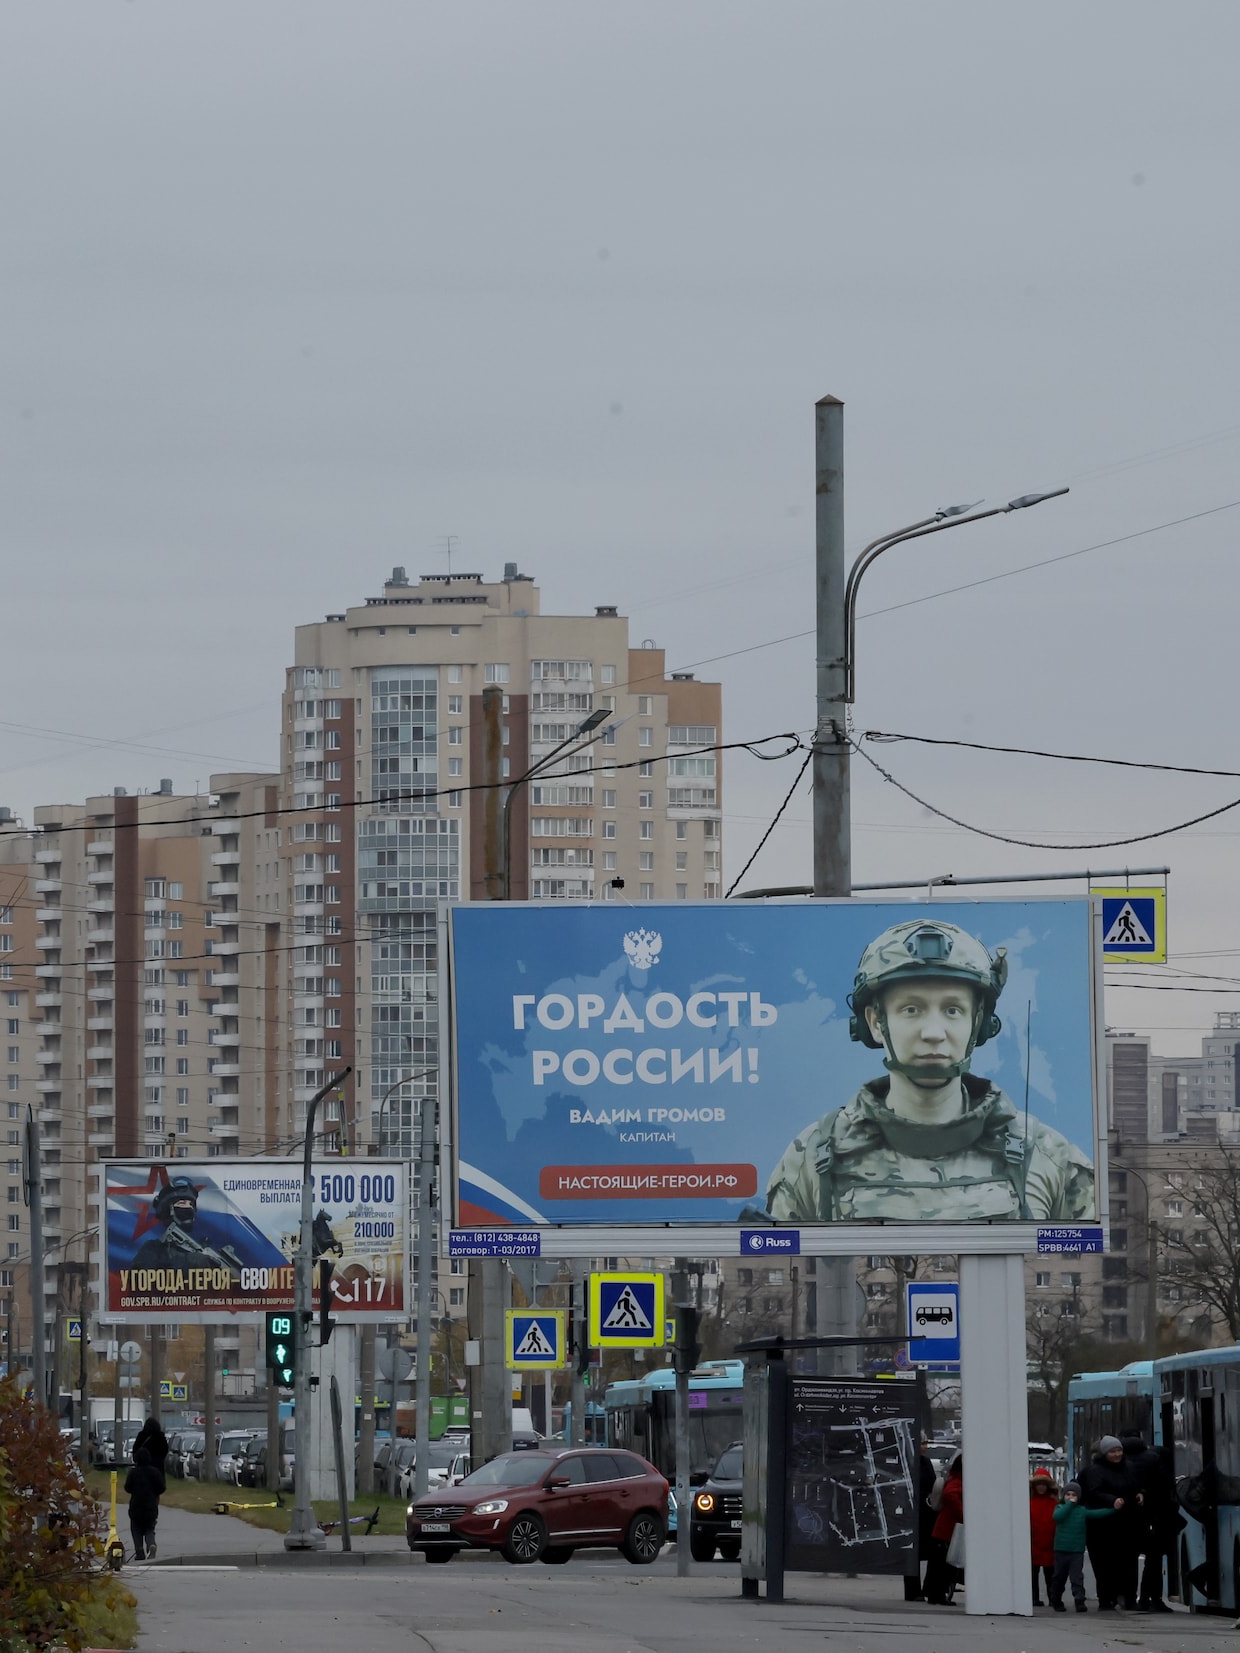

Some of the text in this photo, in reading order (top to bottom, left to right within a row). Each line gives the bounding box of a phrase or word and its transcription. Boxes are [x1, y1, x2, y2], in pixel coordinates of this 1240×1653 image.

[512, 991, 778, 1034] ГОРДОСТЬ
[532, 1047, 760, 1086] РОССИИ!
[569, 1107, 726, 1125] ВАДИМ ГРОМОВ
[619, 1132, 676, 1143] КАПИТАН
[223, 1179, 301, 1192] ЕДИНОВРЕМЕННАЯ
[321, 1174, 355, 1204] 500
[360, 1174, 395, 1204] 000
[558, 1175, 738, 1190] НАСТОЯЩИЕ-ГЕРОИ.РФ
[260, 1192, 301, 1204] ВЫПЛАТА
[354, 1221, 394, 1238] 210 000
[451, 1233, 538, 1242] тел.: (812) 438-4848
[765, 1237, 792, 1247] Russ
[451, 1247, 491, 1256] договор:
[119, 1269, 129, 1292] У
[352, 1277, 386, 1302] 117
[272, 1317, 291, 1335] 09
